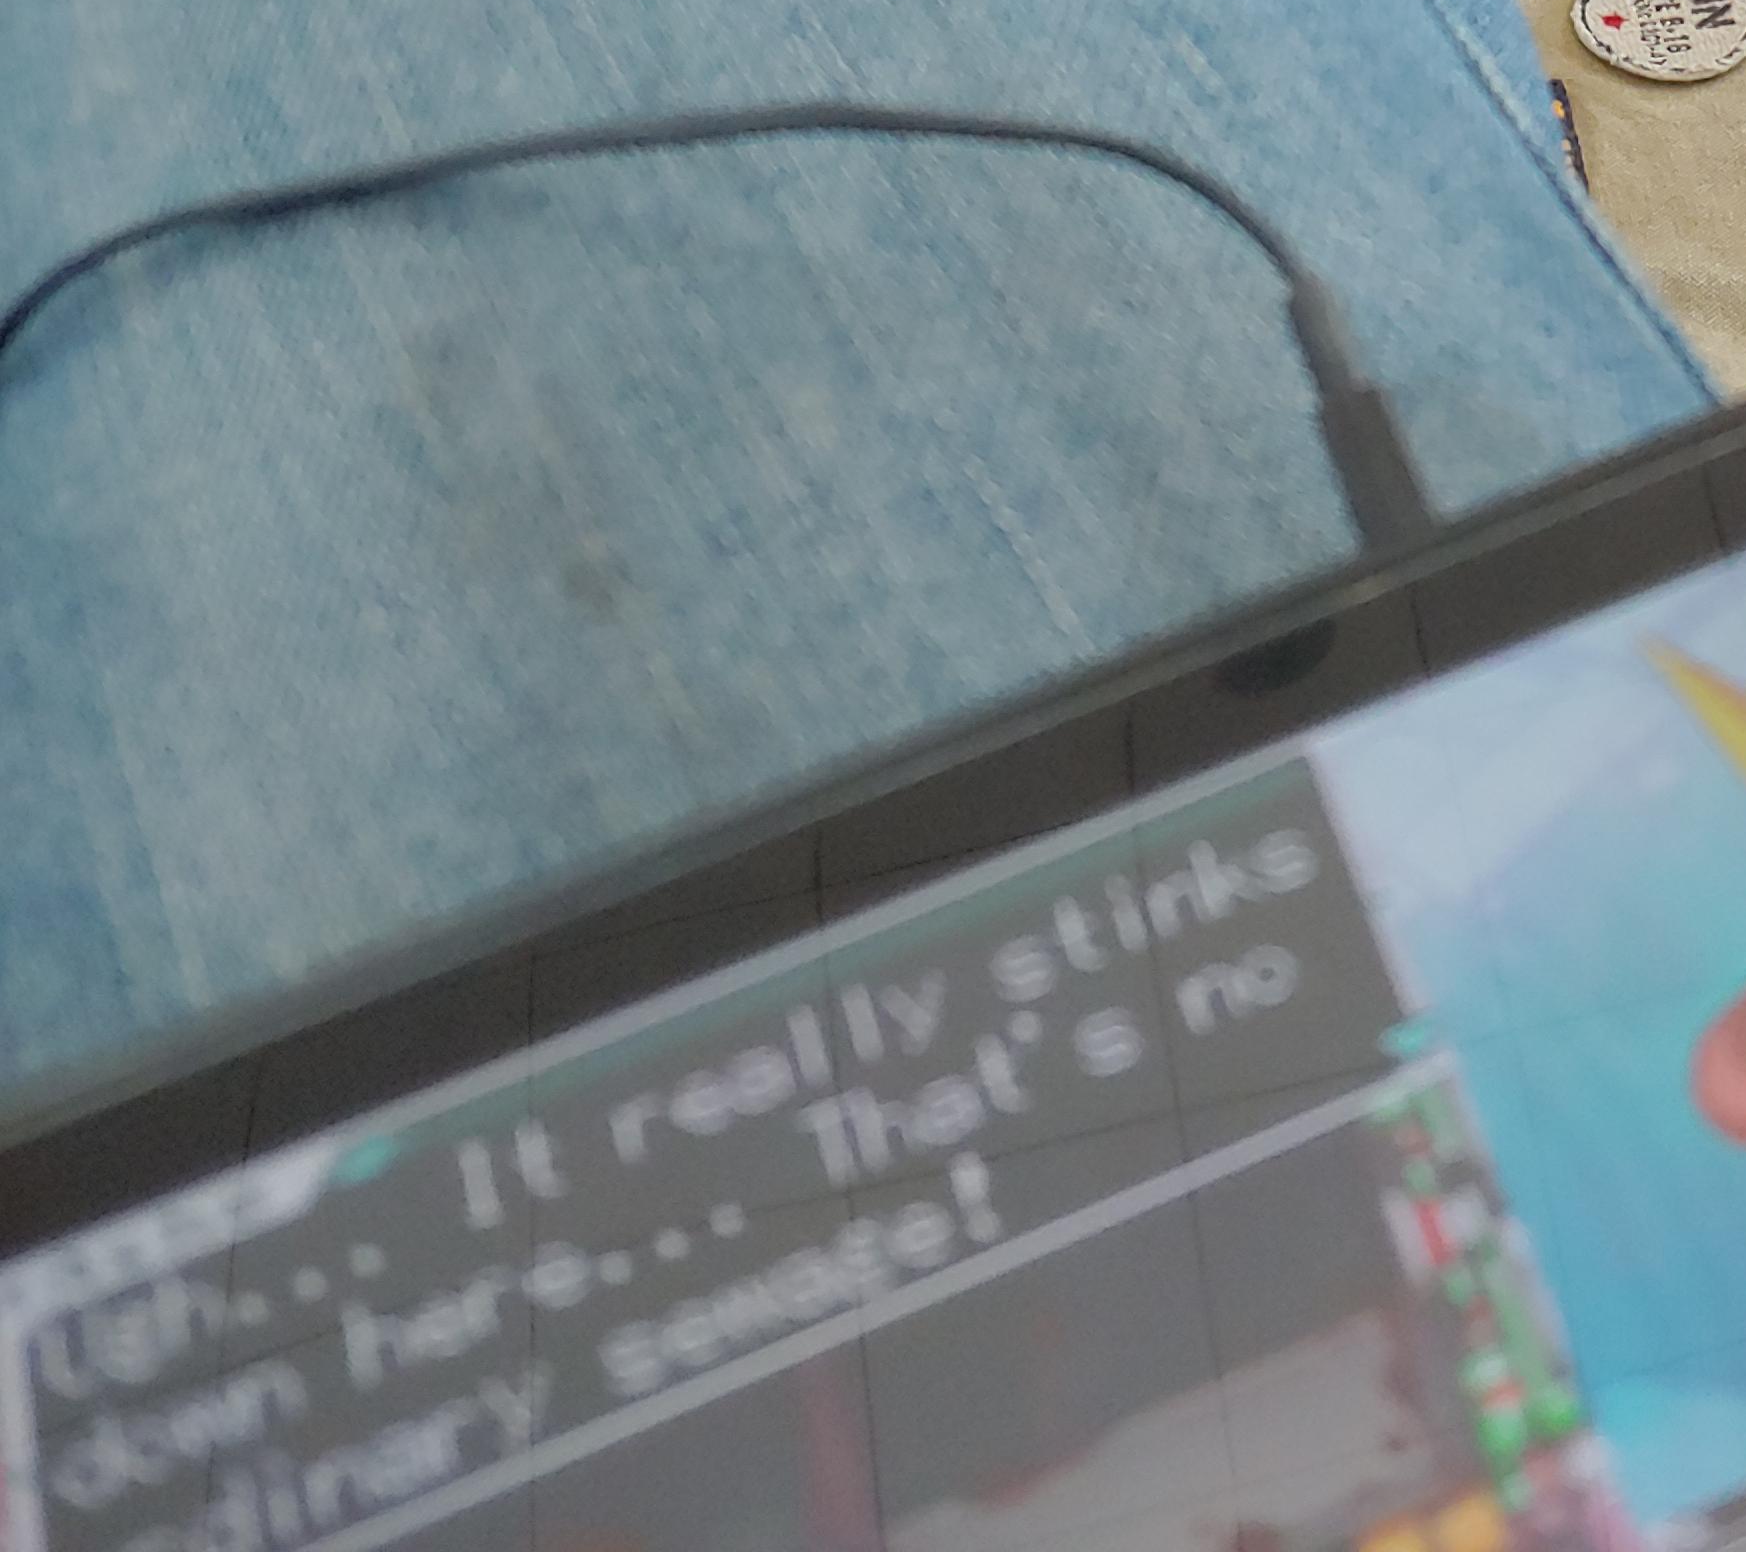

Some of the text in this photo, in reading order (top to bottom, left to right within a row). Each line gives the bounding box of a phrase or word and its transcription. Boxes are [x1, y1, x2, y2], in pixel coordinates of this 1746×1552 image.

[46, 1356, 308, 1512] down
[800, 1003, 1146, 1190] That's
[1175, 942, 1302, 1038] no
[456, 1116, 560, 1231] It
[608, 966, 948, 1166] really
[990, 826, 1322, 1002] stinks
[112, 1360, 553, 1552] dinary
